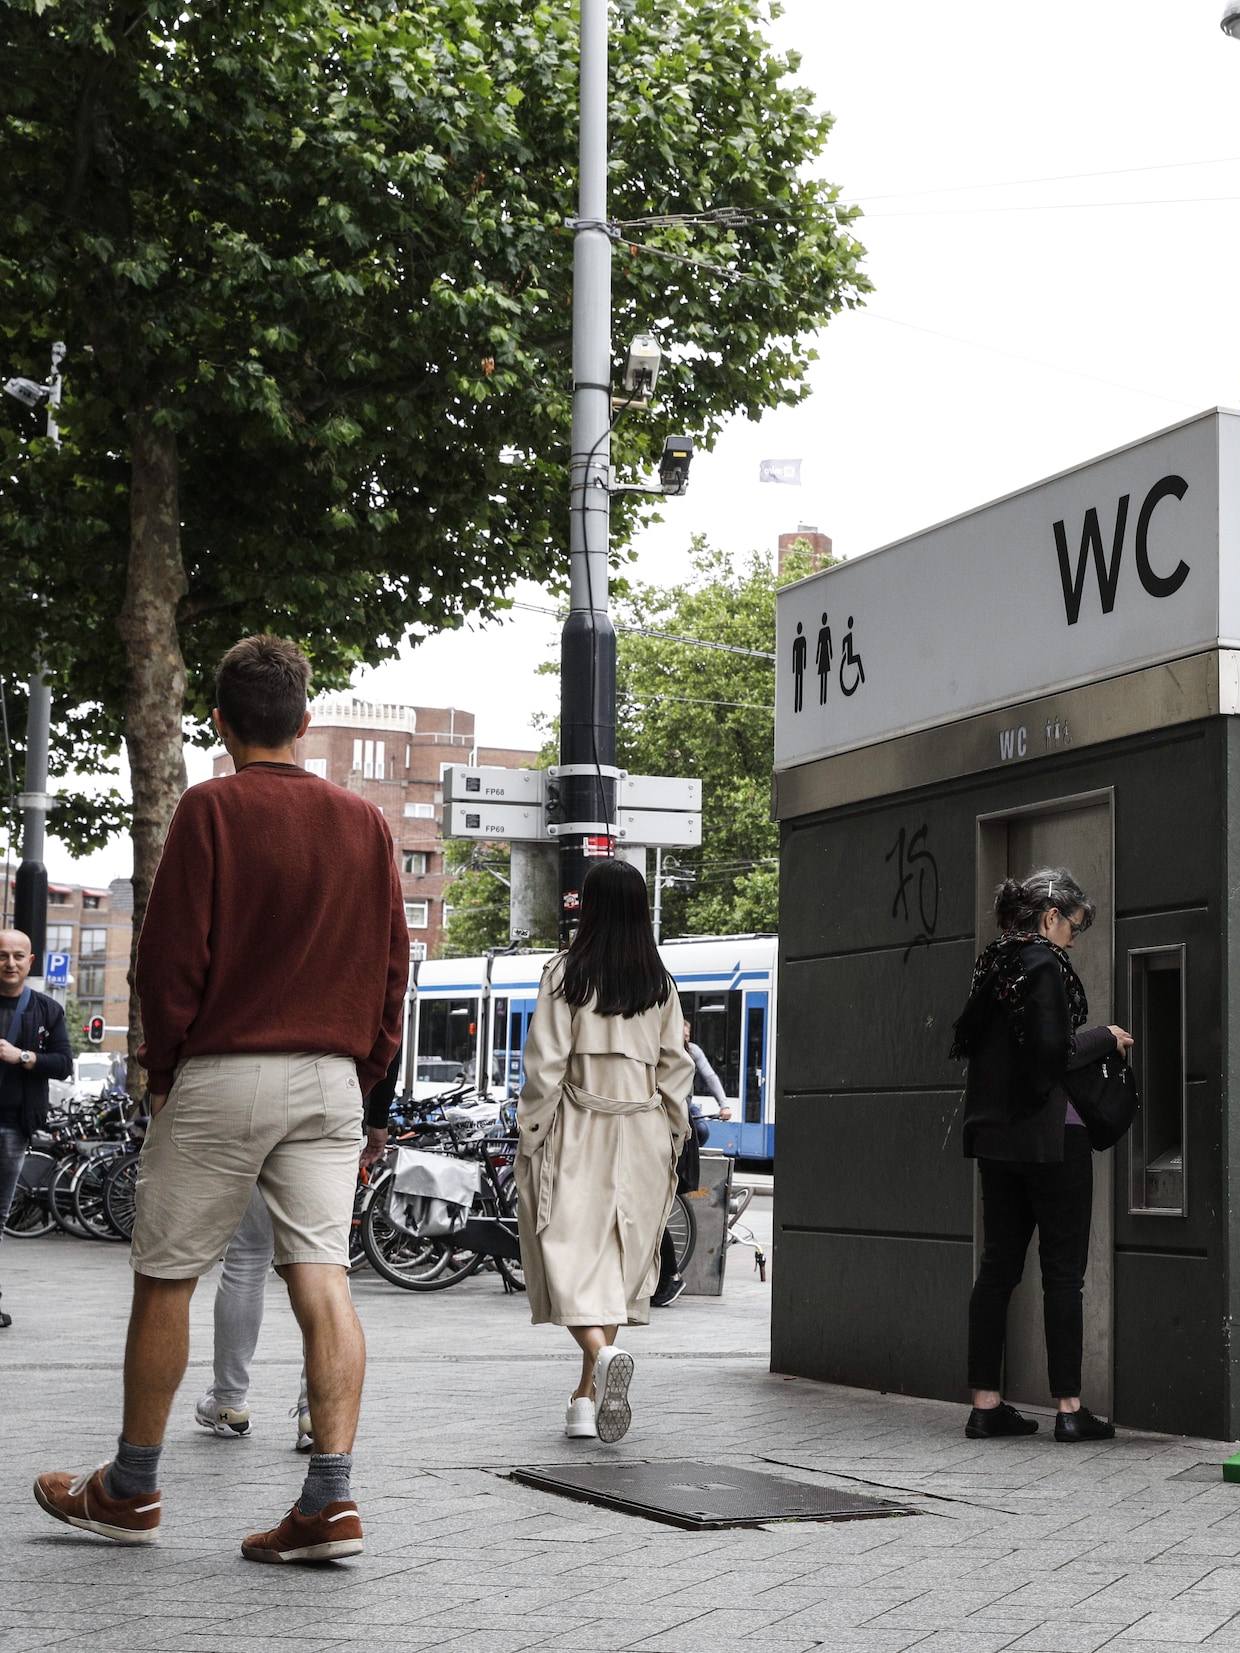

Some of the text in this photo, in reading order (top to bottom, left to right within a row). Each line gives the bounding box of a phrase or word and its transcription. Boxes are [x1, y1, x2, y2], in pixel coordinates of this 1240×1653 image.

[1052, 474, 1191, 626] WC
[999, 726, 1027, 761] WC
[485, 788, 505, 796] FP68
[485, 825, 505, 833] FP69
[50, 955, 65, 972] P
[47, 974, 65, 983] taxi
